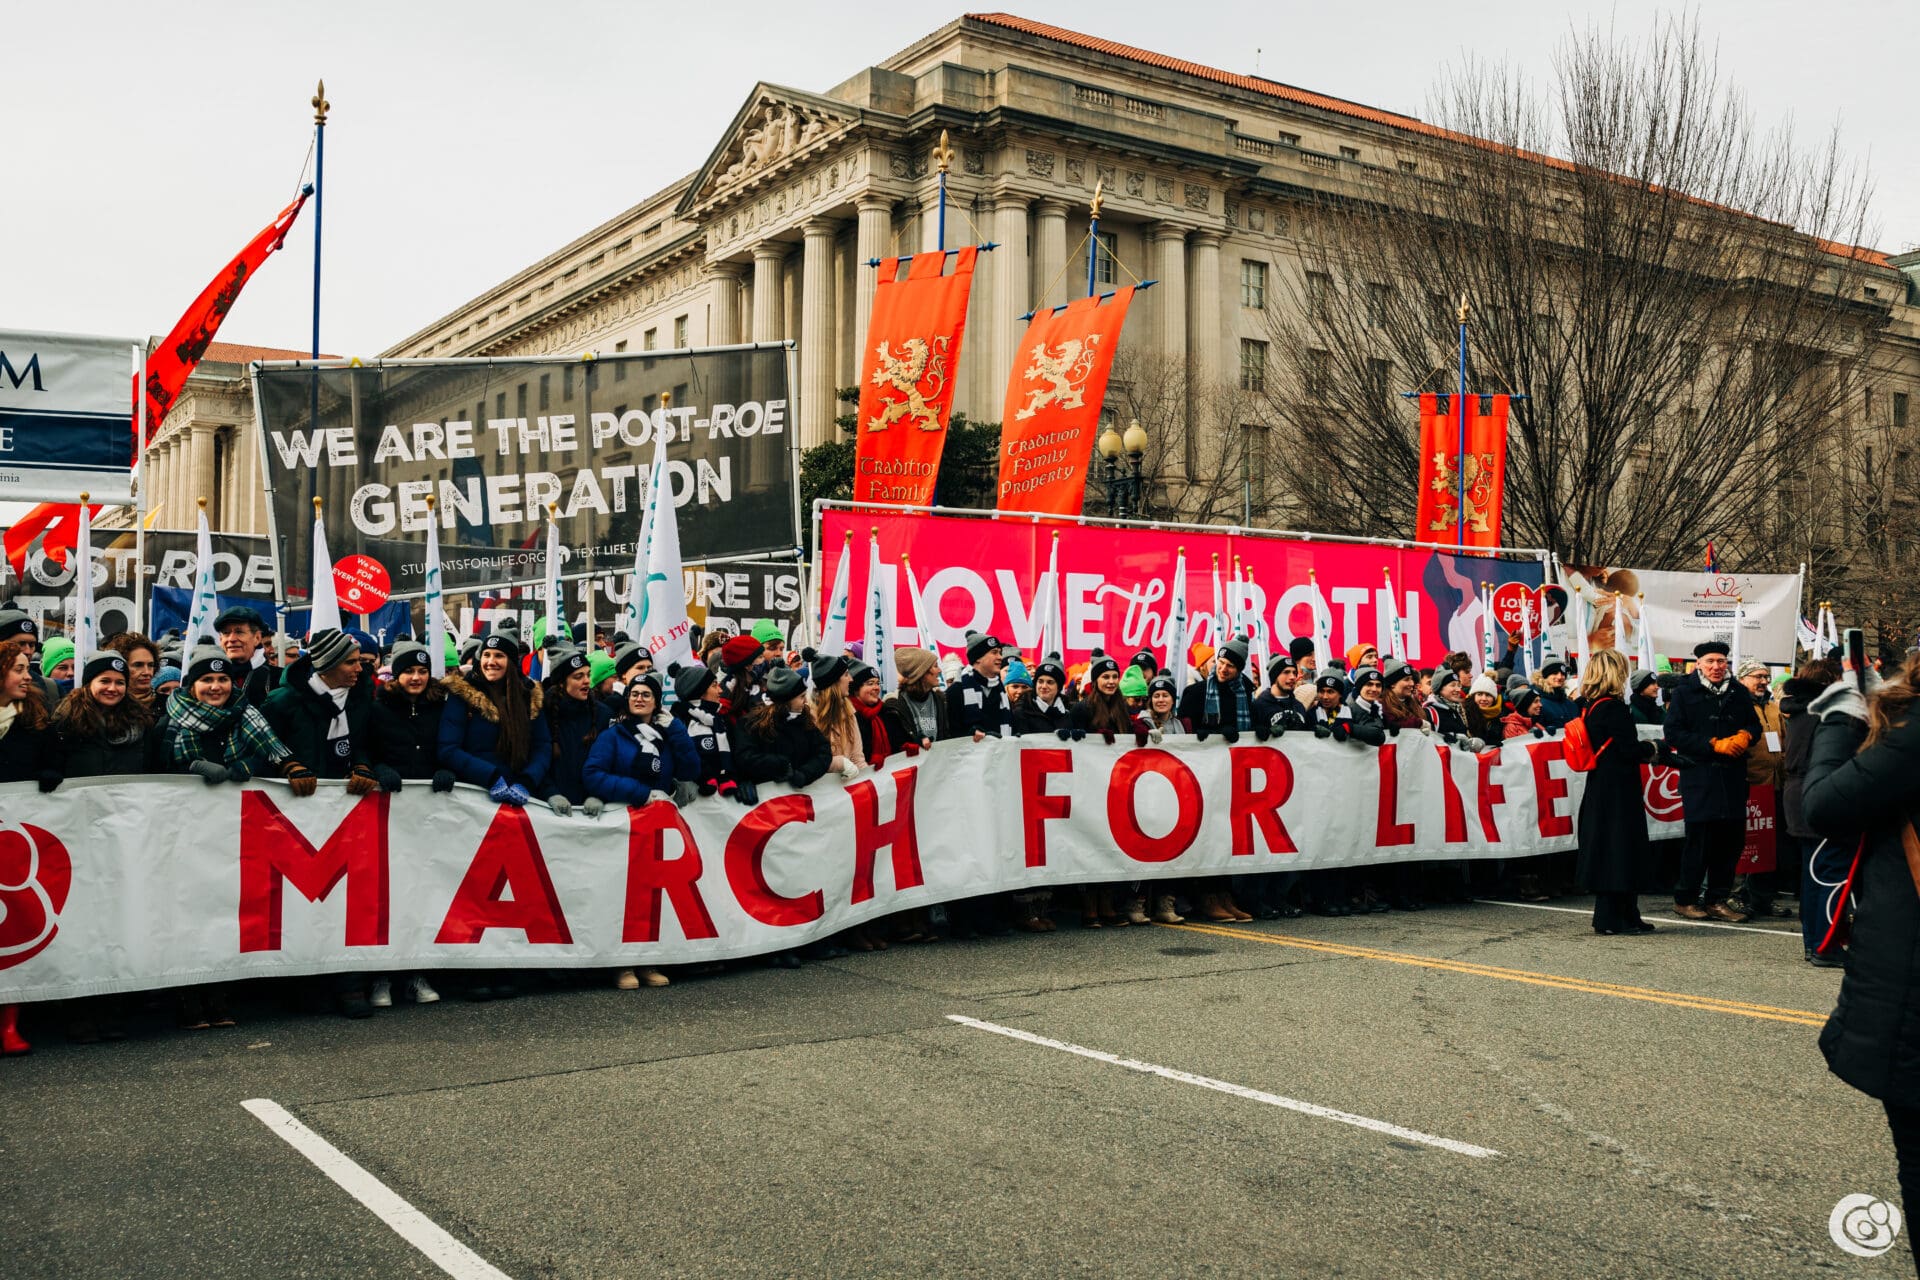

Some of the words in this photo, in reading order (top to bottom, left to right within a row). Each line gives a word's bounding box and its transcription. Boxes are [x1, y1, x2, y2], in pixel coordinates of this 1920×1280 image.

[271, 427, 358, 470] WE
[374, 420, 475, 464] ARE
[488, 414, 578, 456] THE
[591, 399, 787, 449] POST-ROE
[1007, 428, 1080, 457] Tradition
[1013, 448, 1068, 475] Family
[350, 456, 732, 536] GENERATION
[869, 479, 929, 504] Family
[1000, 466, 1075, 499] Property
[356, 568, 374, 581] FOR
[401, 552, 546, 576] STUNTSFORLIFE.ORG
[574, 546, 601, 559] TEXT
[604, 543, 627, 556] LIFE
[331, 567, 357, 583] EVERY
[357, 580, 389, 600] WOMAN
[578, 570, 751, 608] FURE
[764, 574, 801, 612] IS
[878, 564, 1105, 651] LOVE
[1226, 580, 1421, 662] BOTH
[1503, 610, 1540, 623] BOH
[1746, 816, 1774, 831] LIFE
[239, 765, 926, 954] MARCH
[1020, 745, 1299, 868] FOR
[1375, 741, 1574, 847] LIFE
